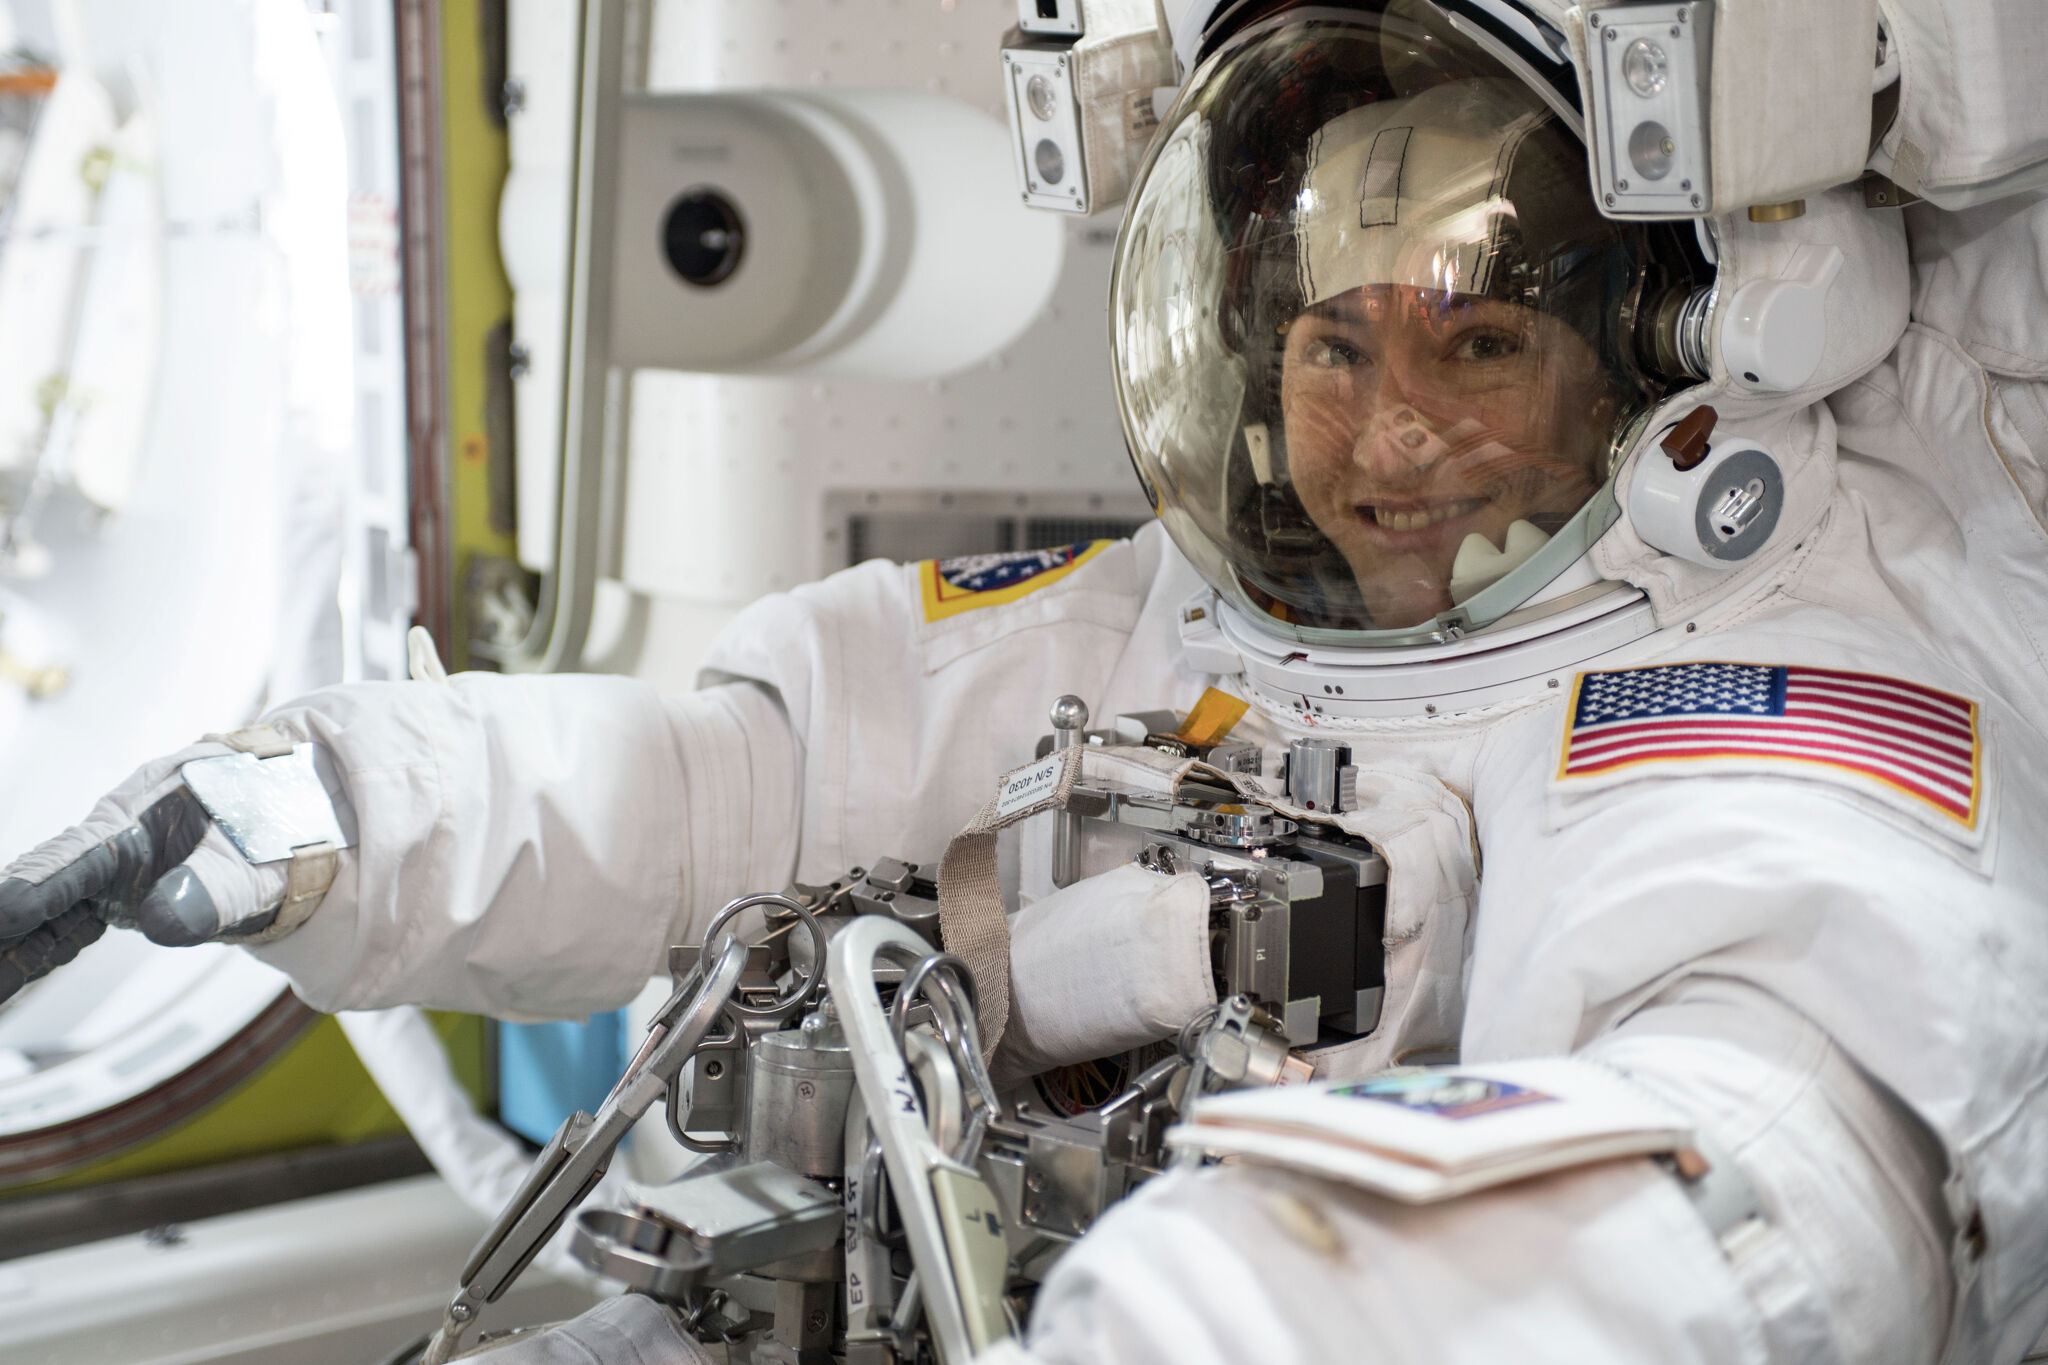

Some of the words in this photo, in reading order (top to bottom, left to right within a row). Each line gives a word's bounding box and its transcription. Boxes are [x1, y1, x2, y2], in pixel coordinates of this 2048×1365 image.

[1034, 766, 1054, 783] S/N
[1008, 776, 1033, 795] 4030
[849, 1271, 864, 1306] EP
